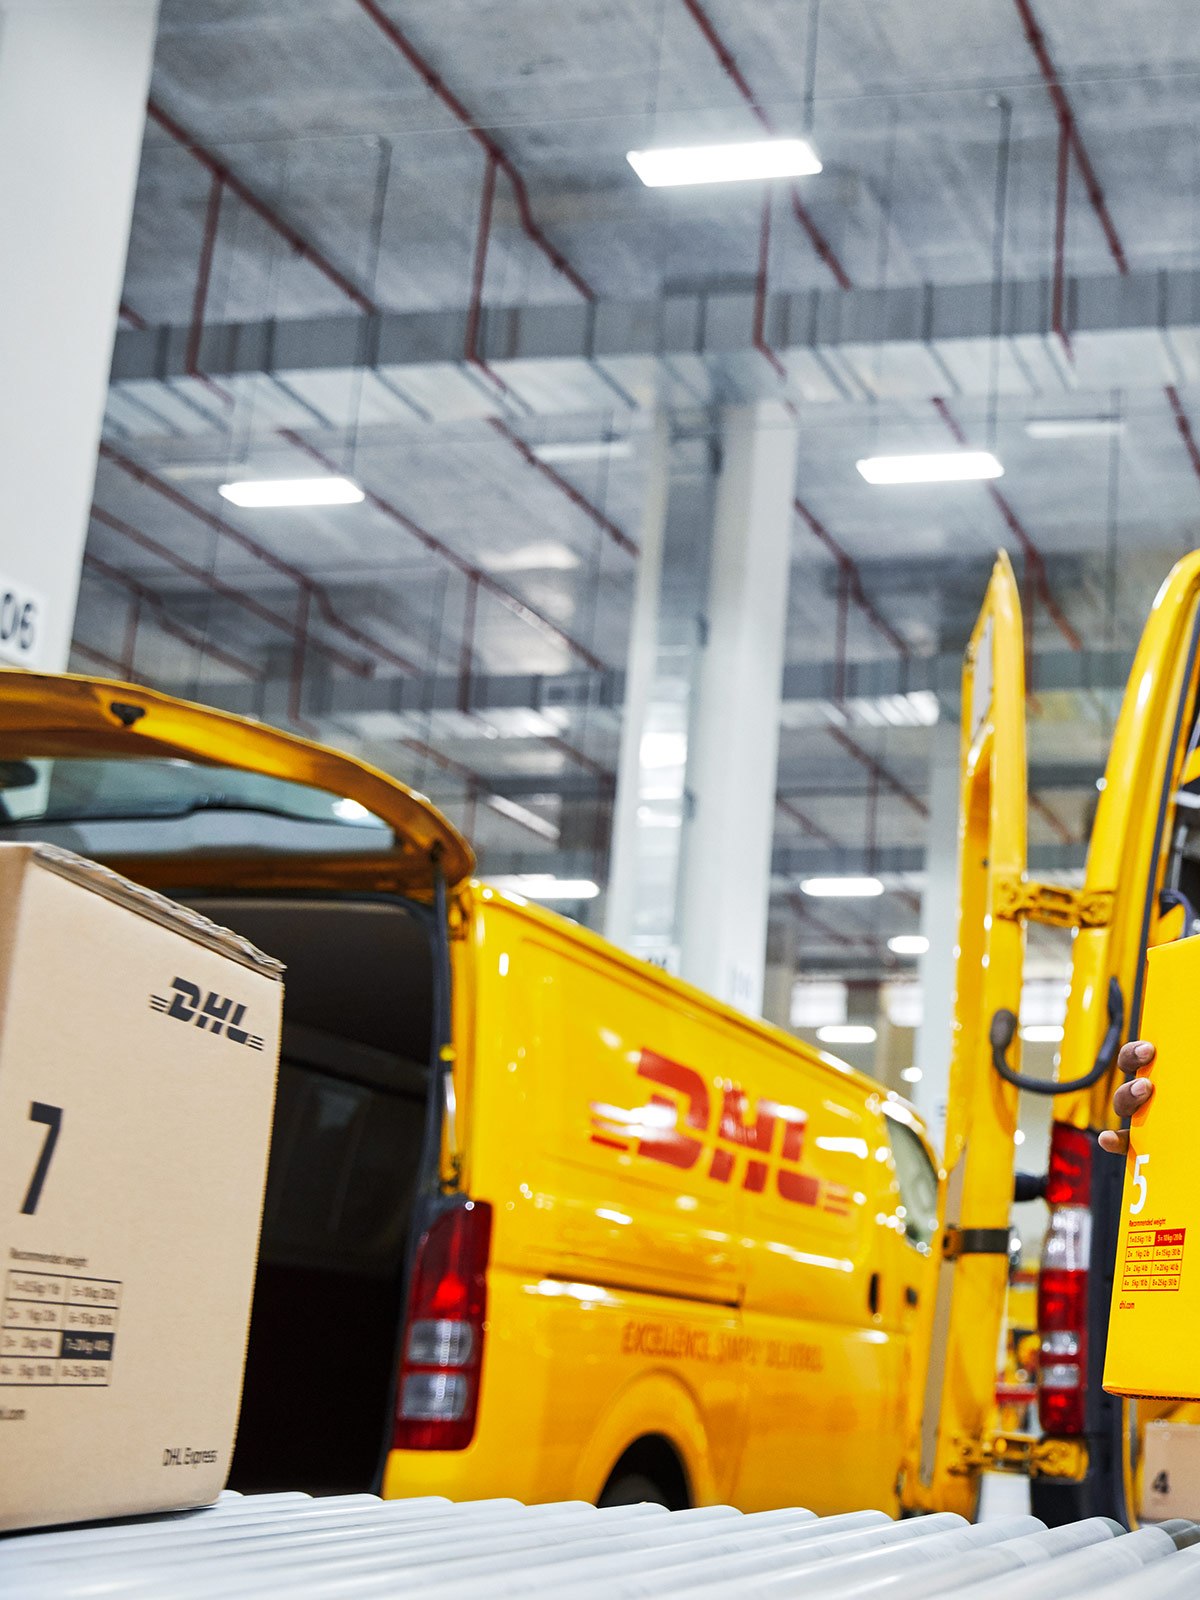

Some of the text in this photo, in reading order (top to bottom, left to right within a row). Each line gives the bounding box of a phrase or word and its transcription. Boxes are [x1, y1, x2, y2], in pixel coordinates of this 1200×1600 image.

[166, 975, 249, 1046] DHL
[20, 1100, 64, 1216] 7
[635, 1046, 821, 1208] DHL
[1129, 1154, 1150, 1216] 5
[163, 1448, 181, 1466] DHL
[1152, 1470, 1170, 1495] 4
